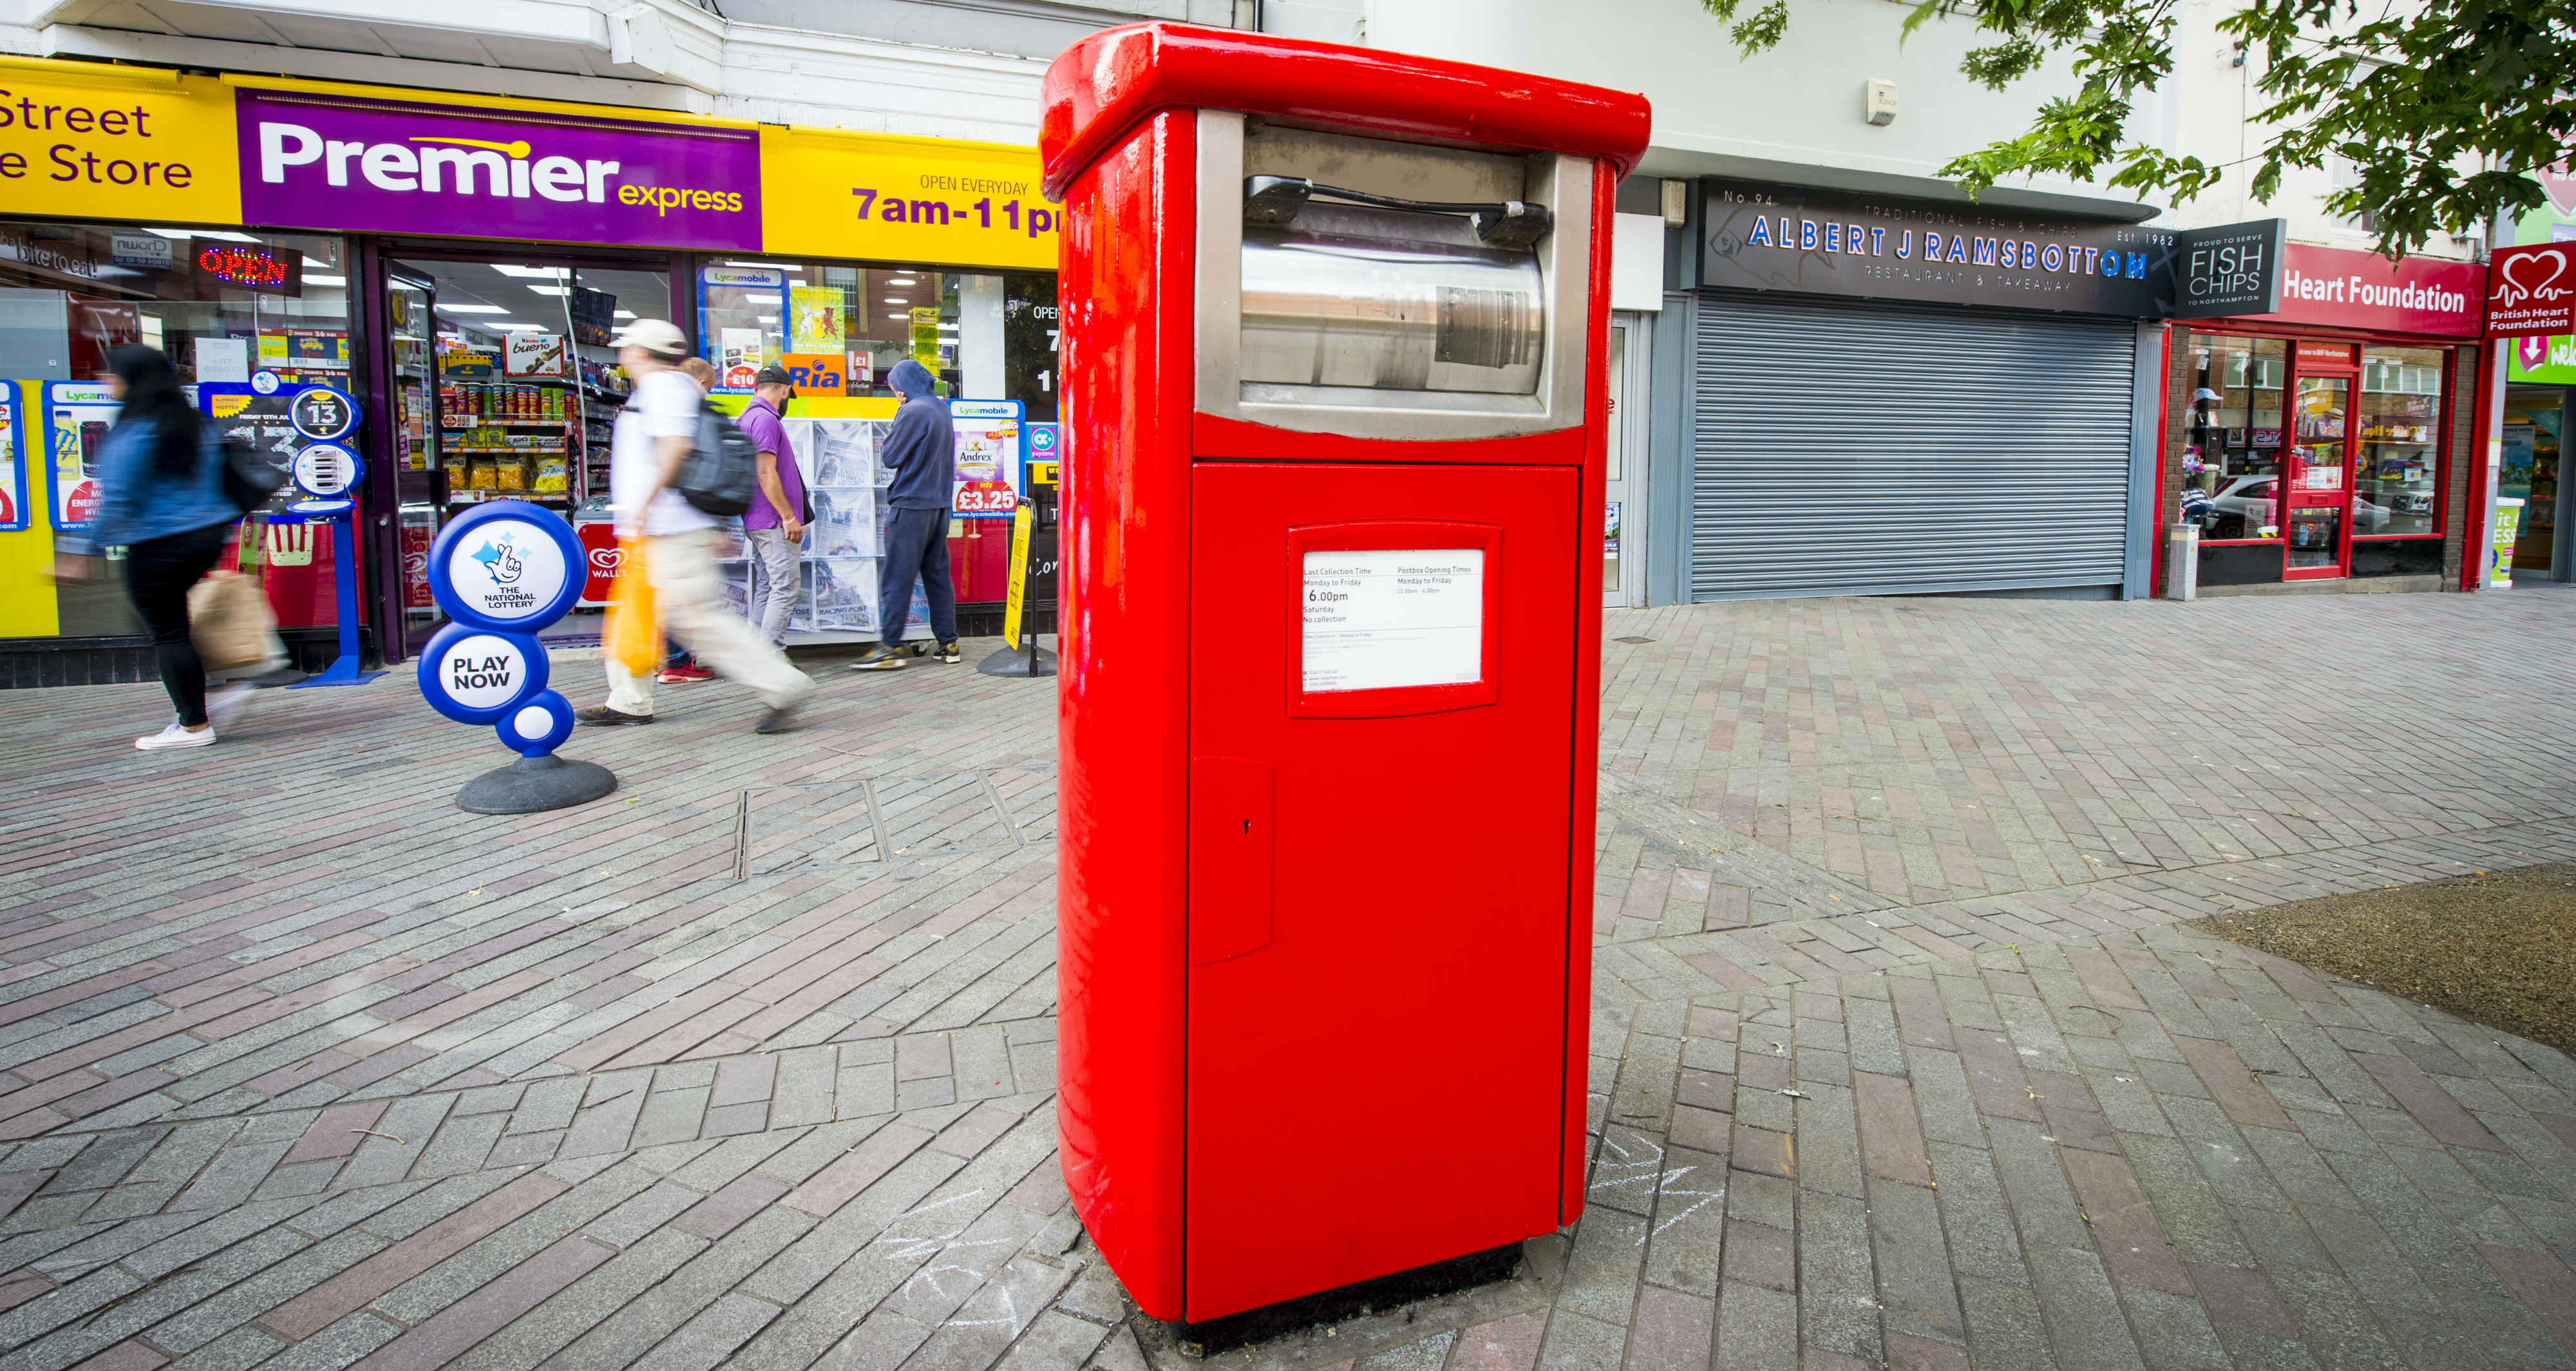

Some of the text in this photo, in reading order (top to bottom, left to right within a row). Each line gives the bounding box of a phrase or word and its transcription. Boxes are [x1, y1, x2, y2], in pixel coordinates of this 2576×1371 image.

[0, 89, 151, 137] Street
[50, 144, 192, 187] Store
[260, 122, 742, 216] Premier express
[920, 175, 1028, 196] OPEN EVERYDAY
[852, 188, 1059, 238] 7am-11p
[1864, 205, 2077, 238] TRADITIONAL FISH & CHIPS
[1747, 214, 2147, 279] ALBERT J RAMSBOTTOM
[2145, 232, 2174, 247] 1982
[2193, 239, 2221, 248] PROUD
[2236, 234, 2262, 243] SERVE
[17, 236, 50, 267] bite
[52, 250, 68, 270] to
[2190, 243, 2263, 278] FISH
[199, 251, 288, 281] OPEN
[714, 272, 770, 283] Lycamobile
[1864, 265, 2071, 292] RESTAURANT & TAKEAWAY
[2190, 271, 2260, 296] CHIPS
[2200, 294, 2259, 305] NORTHAMPTON
[2284, 269, 2465, 313] Heart Foundation
[2490, 307, 2569, 319] British Heart
[2490, 318, 2568, 330] Foundation
[513, 343, 549, 354] bueno
[732, 374, 753, 384] £10
[789, 361, 840, 388] Ria
[307, 405, 336, 424] 13
[960, 407, 1008, 415] Lycamobile
[960, 452, 992, 462] Andrex
[959, 491, 1014, 509] £3.25
[1425, 566, 1451, 575] Opening
[484, 592, 536, 601] NATIONAL
[488, 600, 534, 609] LOTTERY
[1309, 589, 1348, 602] 6.00pm
[454, 656, 509, 673] PLAY
[454, 672, 510, 690] NOW
